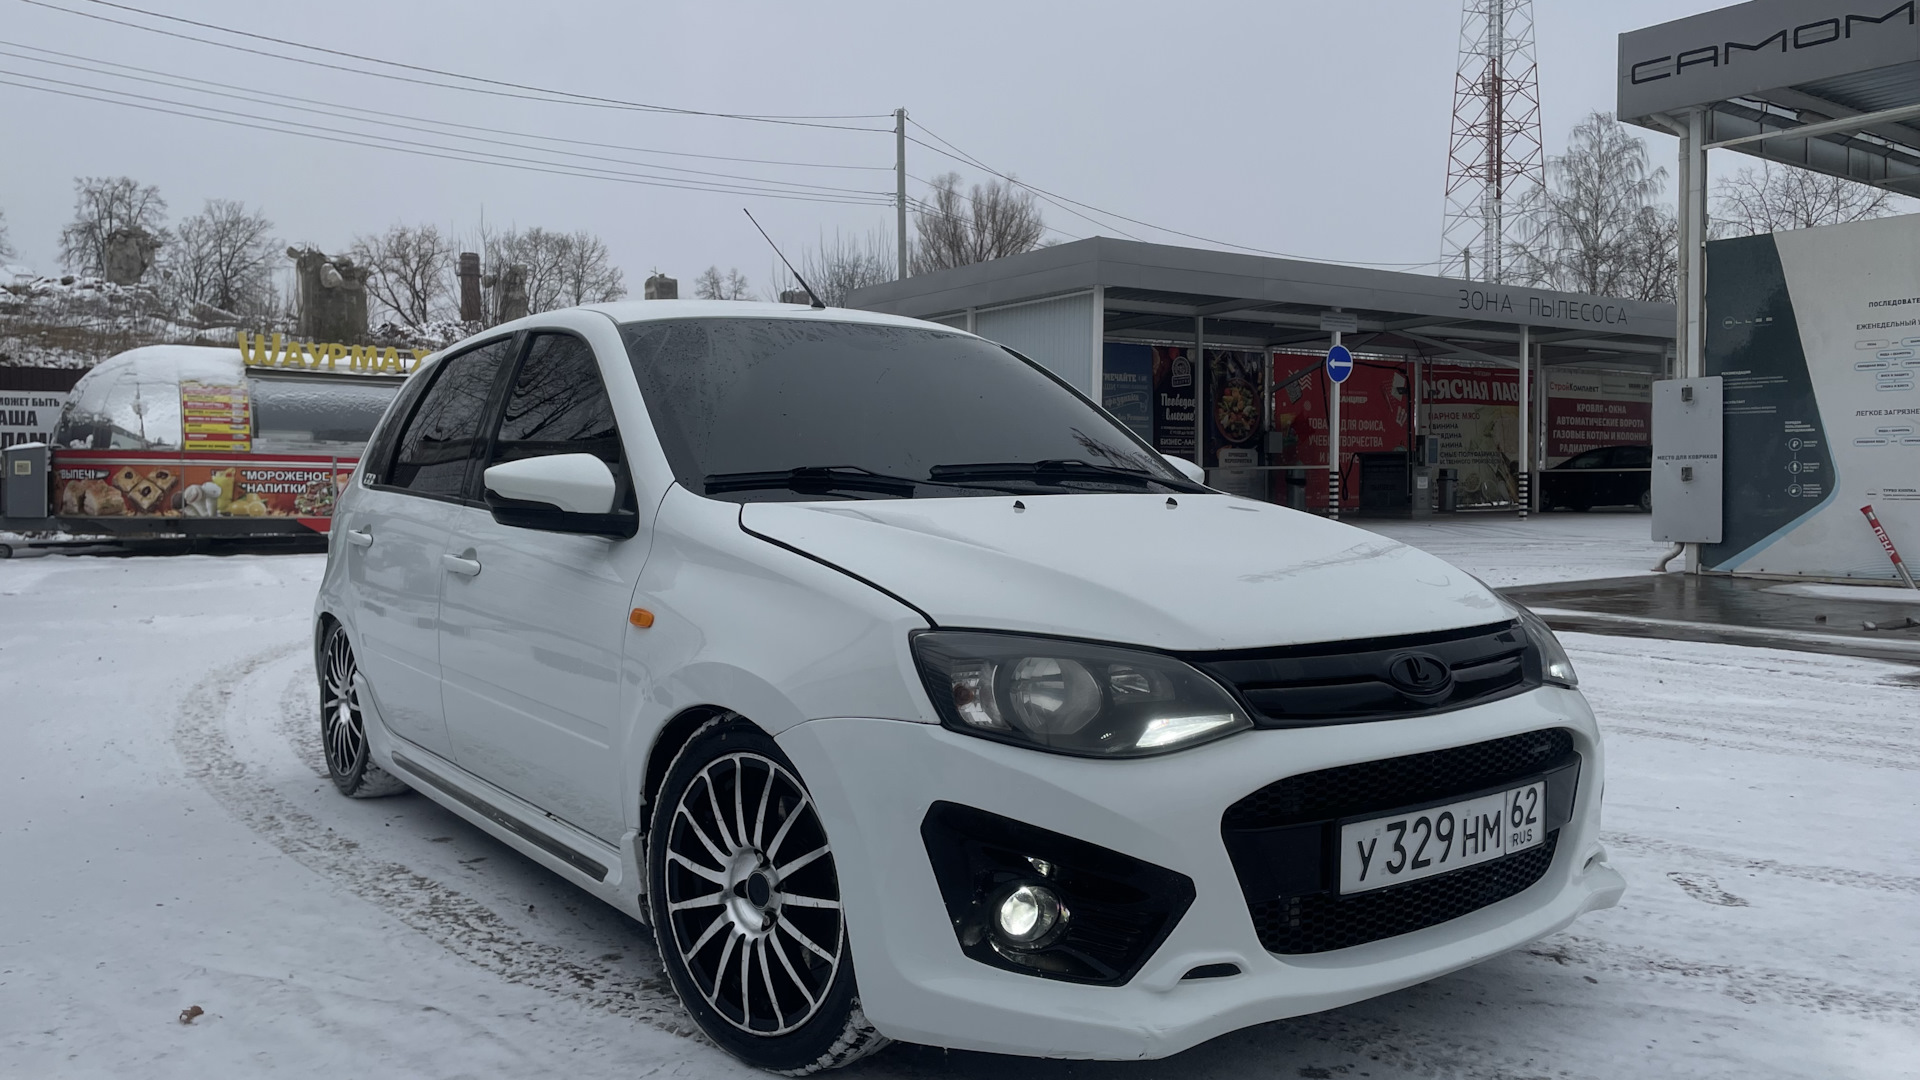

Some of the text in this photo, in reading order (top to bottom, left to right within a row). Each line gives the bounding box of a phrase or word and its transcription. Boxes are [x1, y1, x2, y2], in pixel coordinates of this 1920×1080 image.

[1631, 0, 1915, 85] САМОМ
[1458, 289, 1628, 325] ЗОНА ПЫЛЕСОСА
[1856, 318, 1917, 331] ЕЖЕНЕДЕЛЬНЫЙ
[238, 331, 403, 373] ШАУРМА
[1422, 378, 1490, 400] МЯСНАЯ
[32, 397, 60, 407] БЫТЬ
[1161, 393, 1196, 409] Пообедае
[1339, 395, 1368, 404] АНЦЛЕР
[1462, 412, 1481, 420] МЯСО
[1576, 403, 1627, 414] КРОВЛЯ ОКНА
[1341, 418, 1357, 432] ДЛЯ
[1358, 420, 1386, 433] ОФИСА,
[1556, 415, 1645, 428] АВТОМАТИЧЕСКИЕ ВОРОТА
[1308, 434, 1330, 446] УЧЕБ
[1552, 429, 1648, 441] ГАЗОВЫЕ КОТЛЫ И КОЛОНКИ
[1874, 526, 1896, 557] ПЕНА
[1511, 787, 1538, 829] 62
[1511, 829, 1533, 848] RUS
